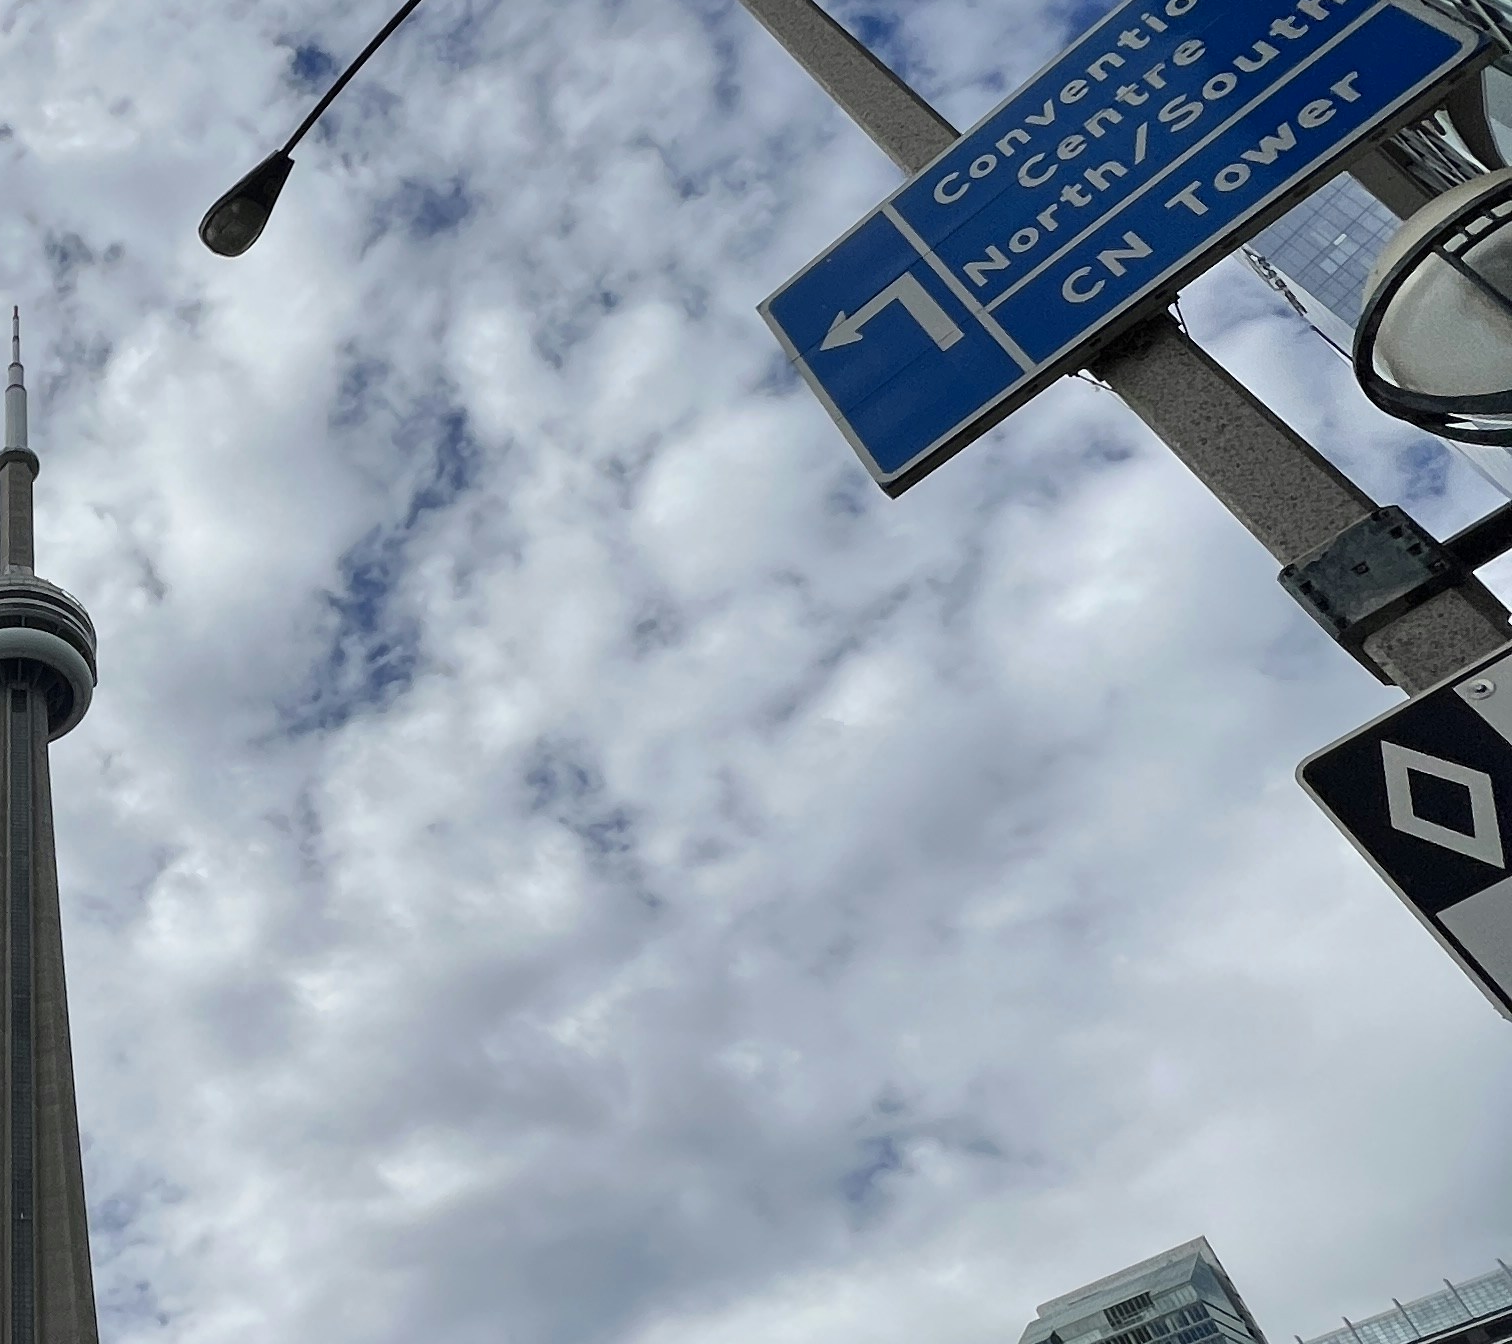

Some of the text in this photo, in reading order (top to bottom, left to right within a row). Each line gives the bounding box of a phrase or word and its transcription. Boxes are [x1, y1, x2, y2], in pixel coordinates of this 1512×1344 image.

[1017, 37, 1206, 188] Centre
[1061, 71, 1361, 303] CN Tower
